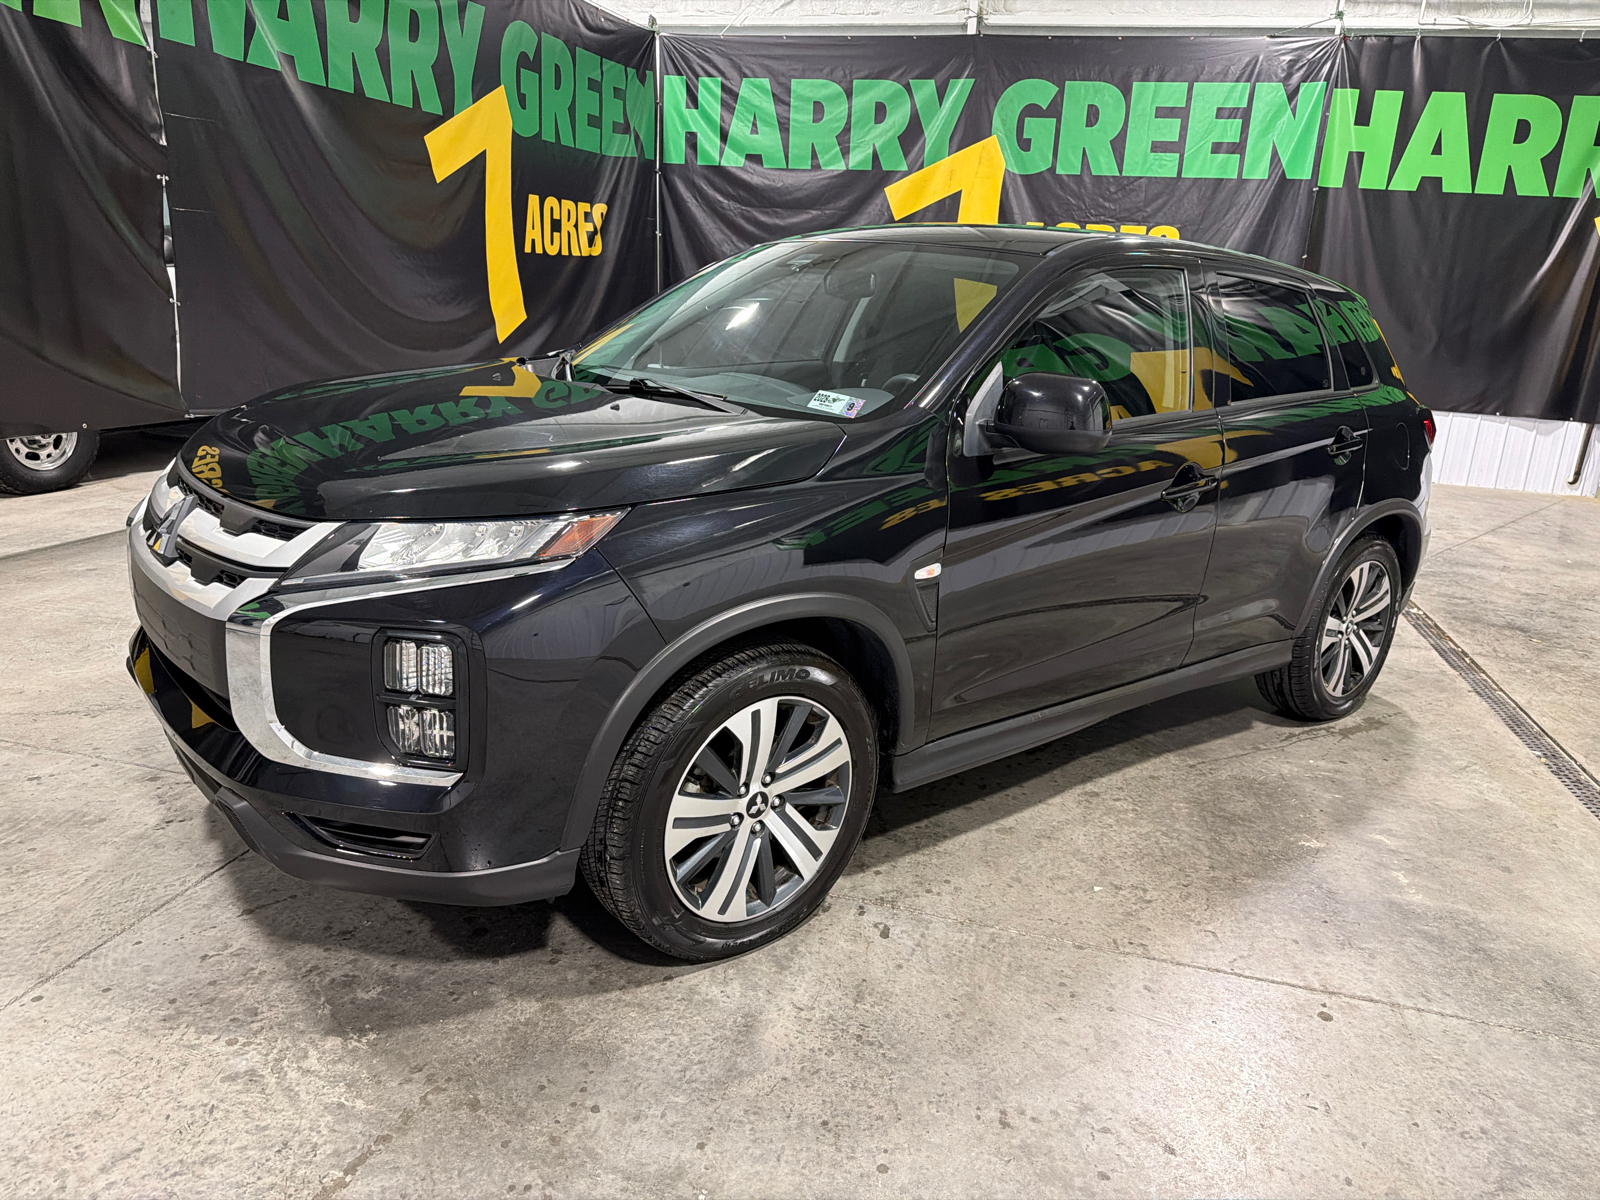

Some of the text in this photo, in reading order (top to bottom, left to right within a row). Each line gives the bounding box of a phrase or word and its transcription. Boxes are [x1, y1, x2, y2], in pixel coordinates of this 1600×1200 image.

[500, 20, 656, 160] GREEN
[663, 75, 1328, 180] HARRY GREEN
[424, 84, 608, 344] 7 ACRES
